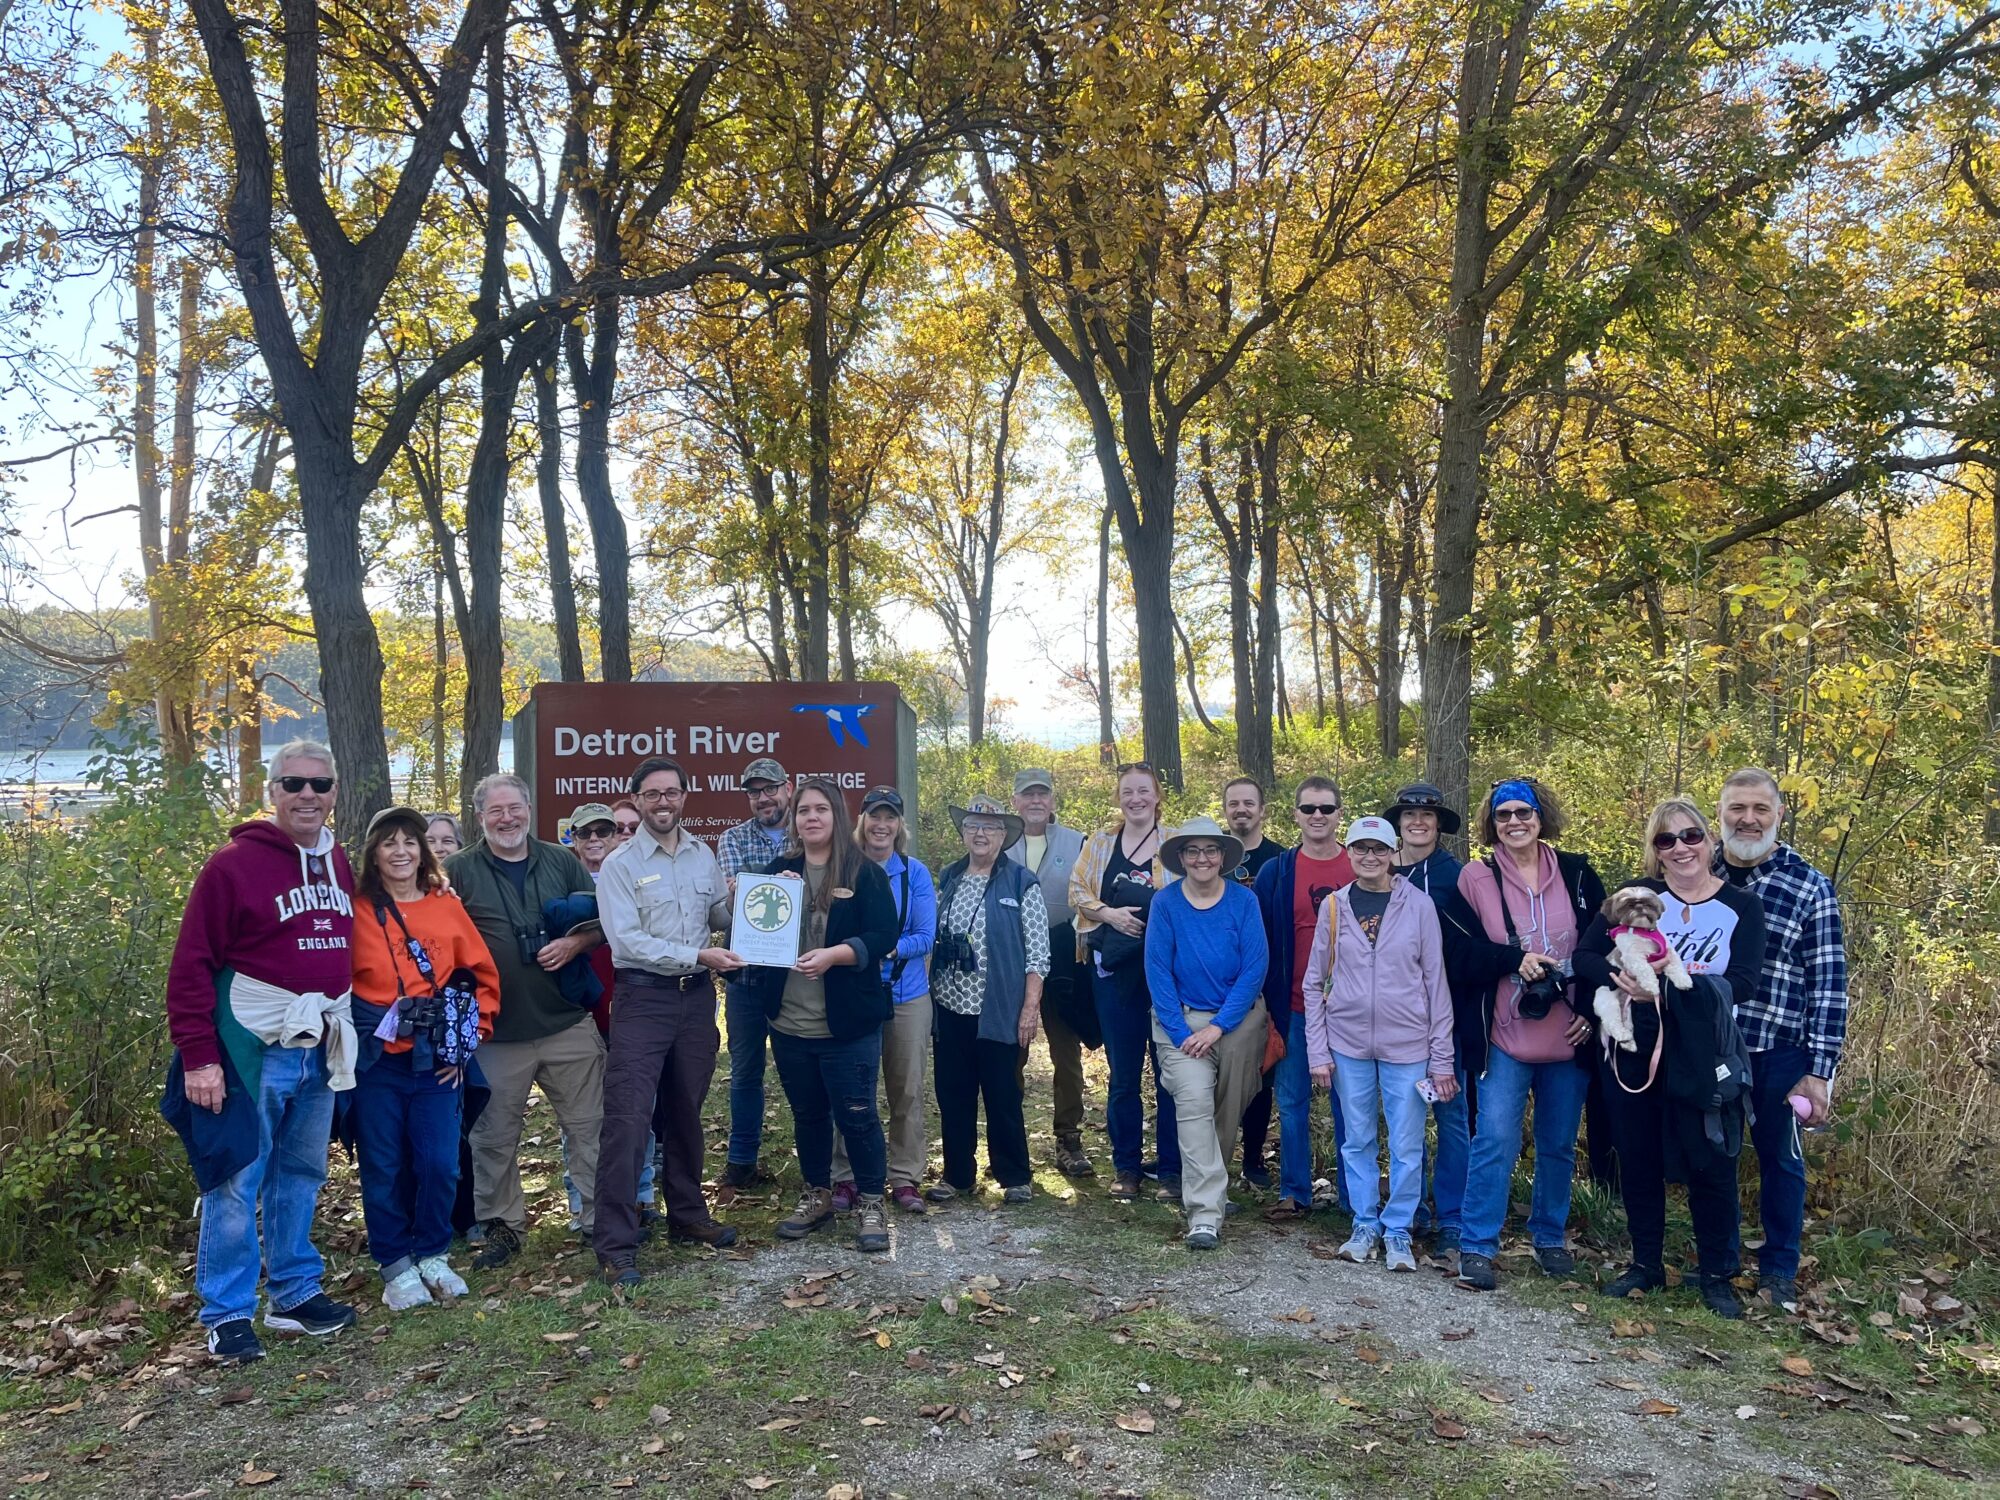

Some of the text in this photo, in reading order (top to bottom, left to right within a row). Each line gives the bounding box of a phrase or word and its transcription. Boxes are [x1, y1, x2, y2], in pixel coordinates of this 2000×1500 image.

[555, 725, 780, 756] Detroit River
[679, 815, 742, 827] ldlife Service
[297, 936, 348, 950] ENGLAND
